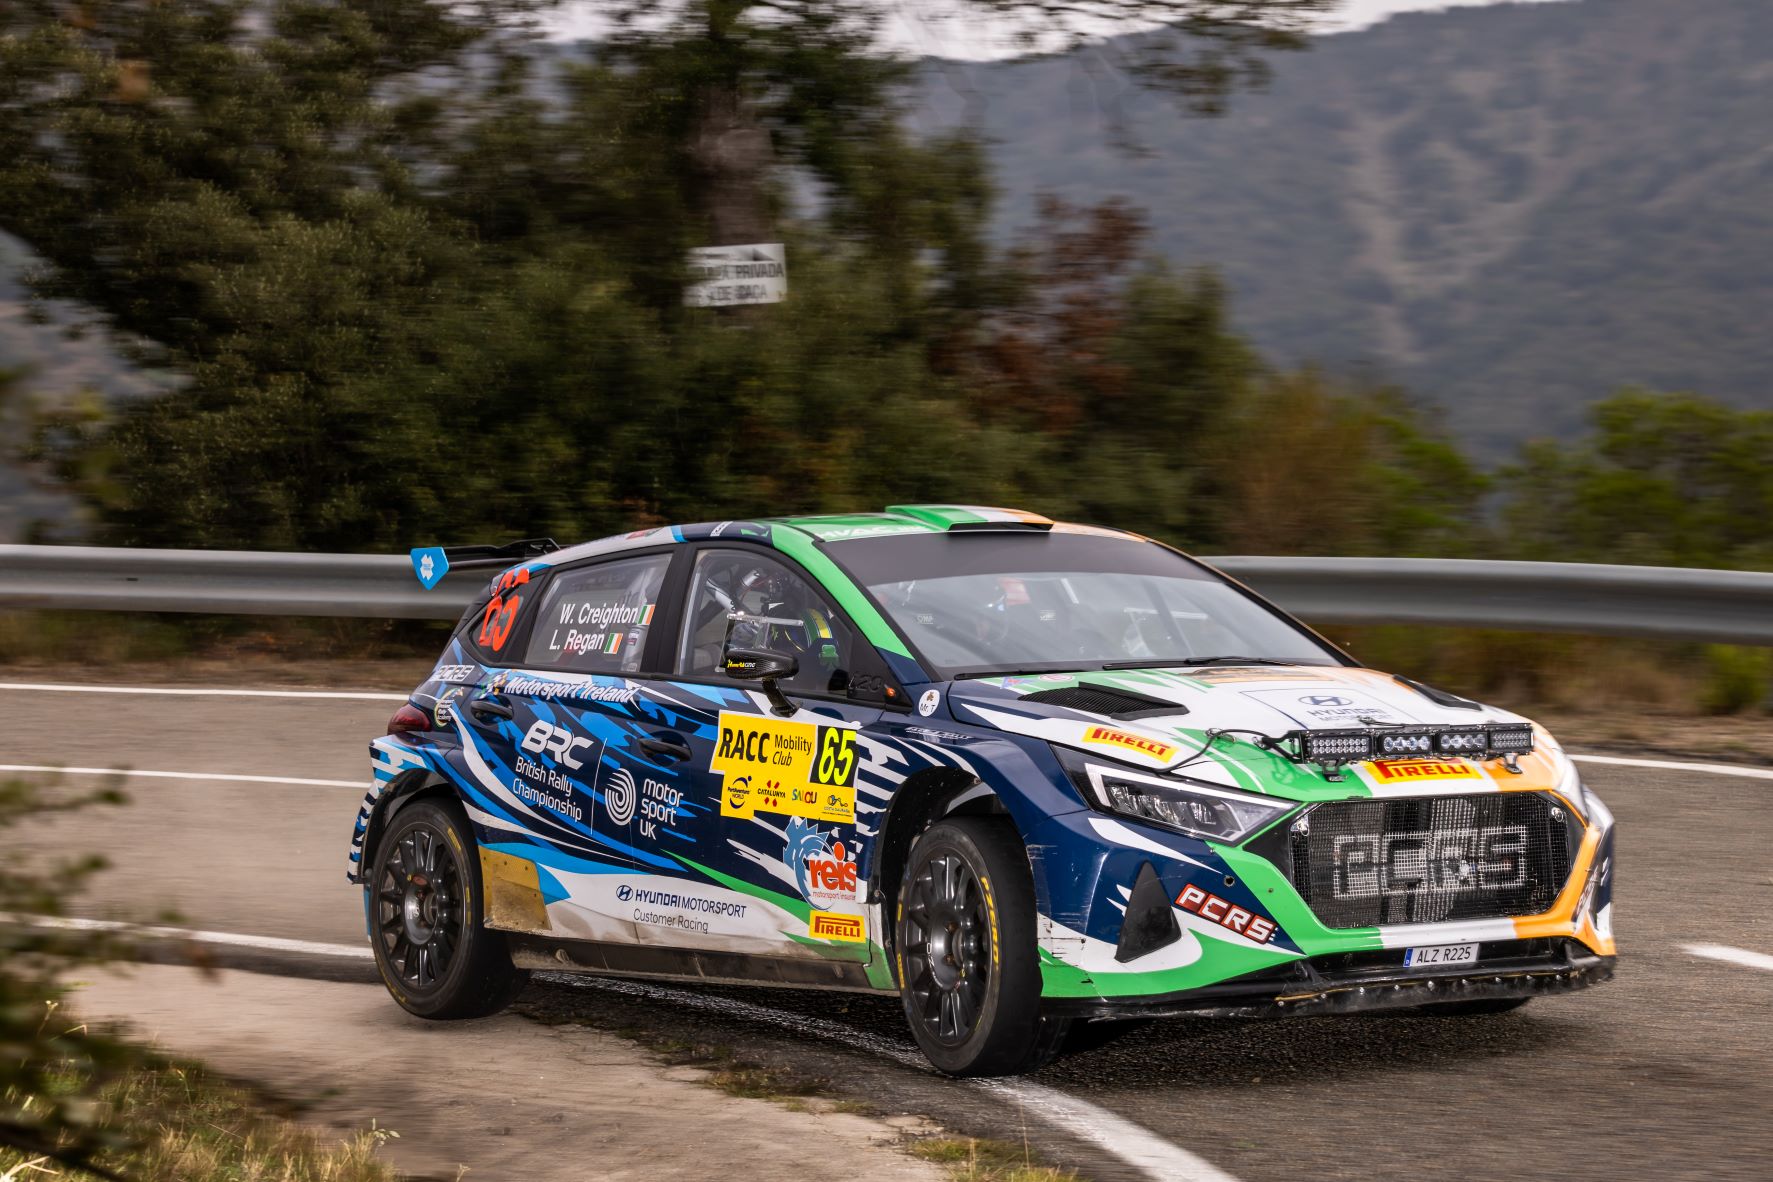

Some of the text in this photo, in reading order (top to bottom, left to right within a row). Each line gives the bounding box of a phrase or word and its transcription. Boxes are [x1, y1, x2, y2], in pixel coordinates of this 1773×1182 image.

[735, 263, 784, 279] PRIVADA
[560, 603, 638, 629] W. Creighton
[549, 629, 560, 650] L.
[564, 629, 605, 655] Regan
[504, 676, 637, 703] Motorsport Ireland
[521, 719, 594, 770] BRC
[718, 727, 770, 763] RACC
[774, 734, 812, 756] Mobility
[1092, 727, 1170, 756] PIRELLI
[772, 751, 792, 767] Club
[818, 727, 857, 786] 65
[1374, 759, 1470, 779] PIRELLI
[515, 757, 573, 797] British Rally
[513, 778, 582, 822] Championship
[643, 778, 684, 807] motor
[757, 788, 786, 798] CATALUNYA
[641, 799, 677, 826] sport
[639, 821, 657, 840] UK
[809, 842, 857, 892] reis
[636, 889, 747, 918] HYUNDAI MOTORSPORT
[1179, 886, 1274, 942] PCRS
[633, 908, 709, 934] Customer Racing
[815, 916, 860, 937] PIRELLI
[1416, 946, 1471, 963] ALZ R225
